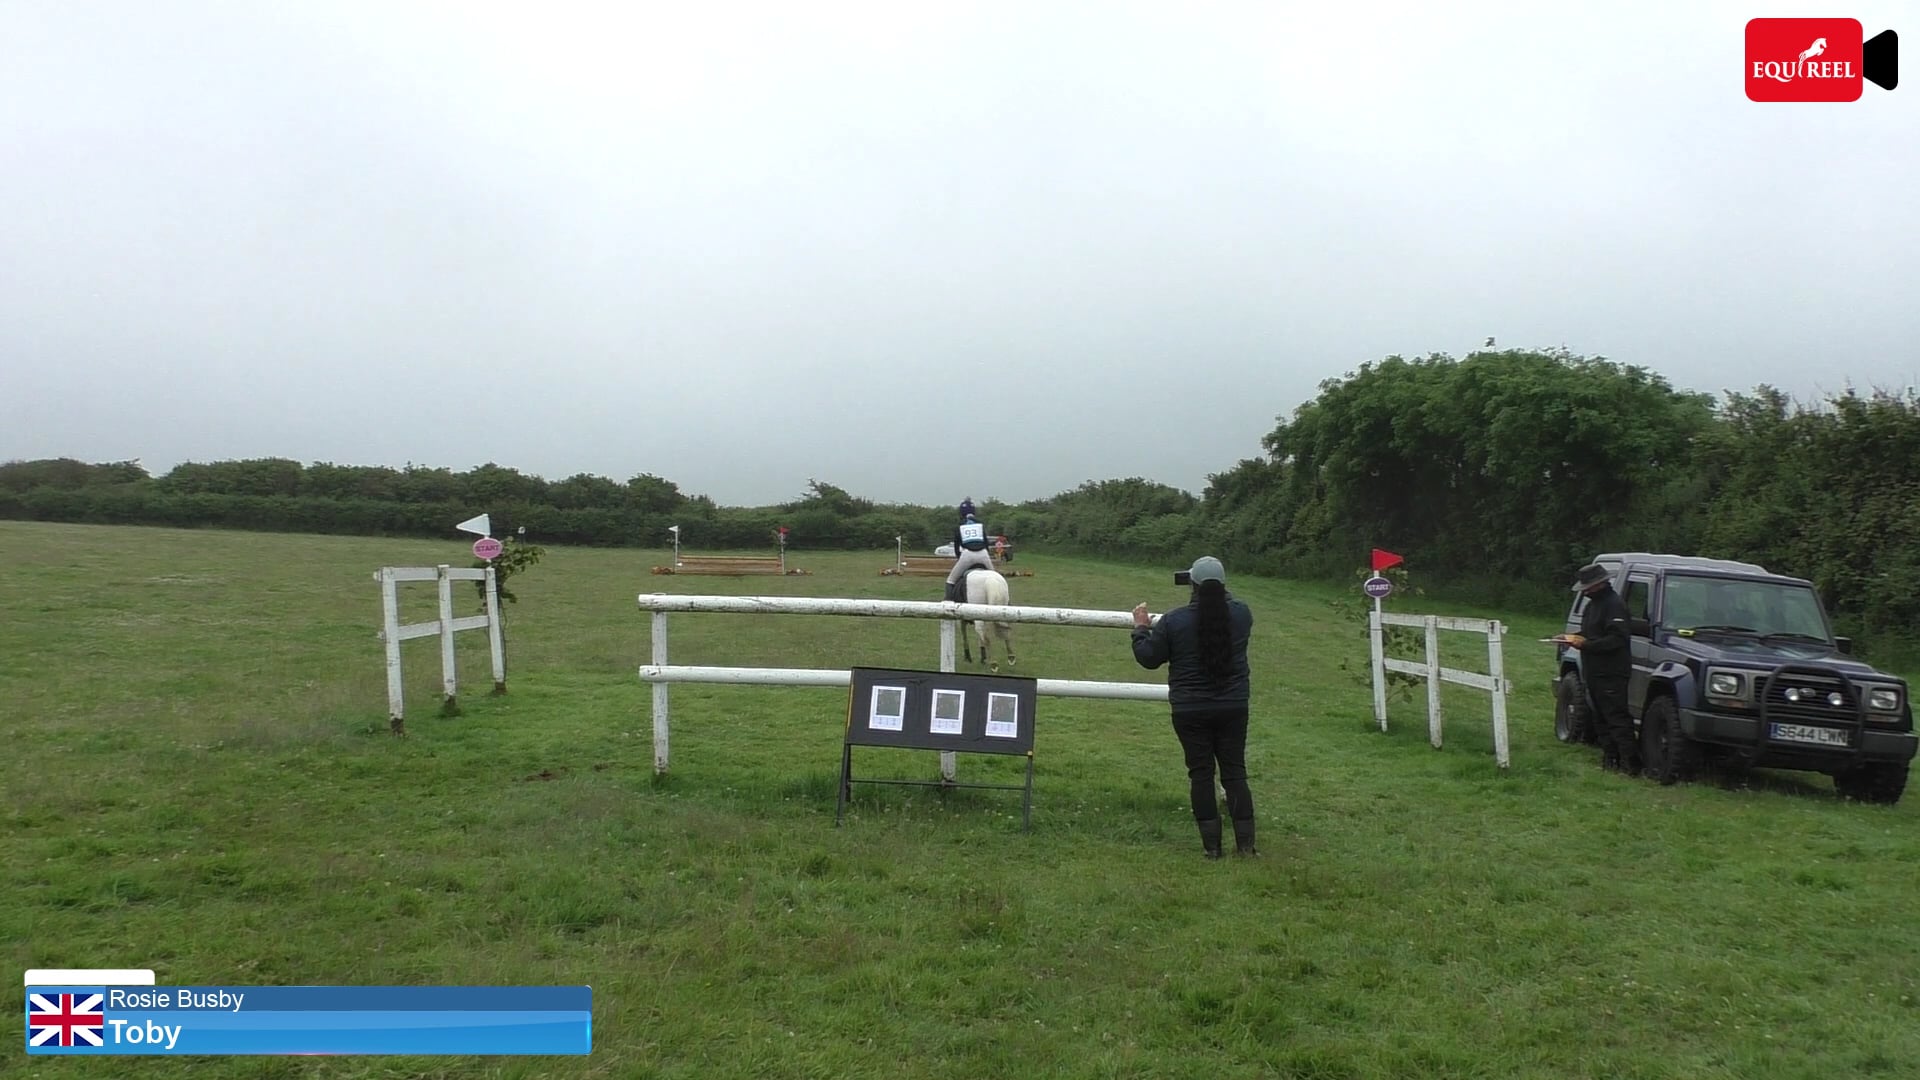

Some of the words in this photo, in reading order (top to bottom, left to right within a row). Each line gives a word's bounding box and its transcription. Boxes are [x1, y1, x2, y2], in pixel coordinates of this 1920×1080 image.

[964, 529, 977, 538] 93
[1367, 583, 1389, 592] START
[1777, 726, 1815, 742] S644
[1818, 728, 1847, 745] LWN
